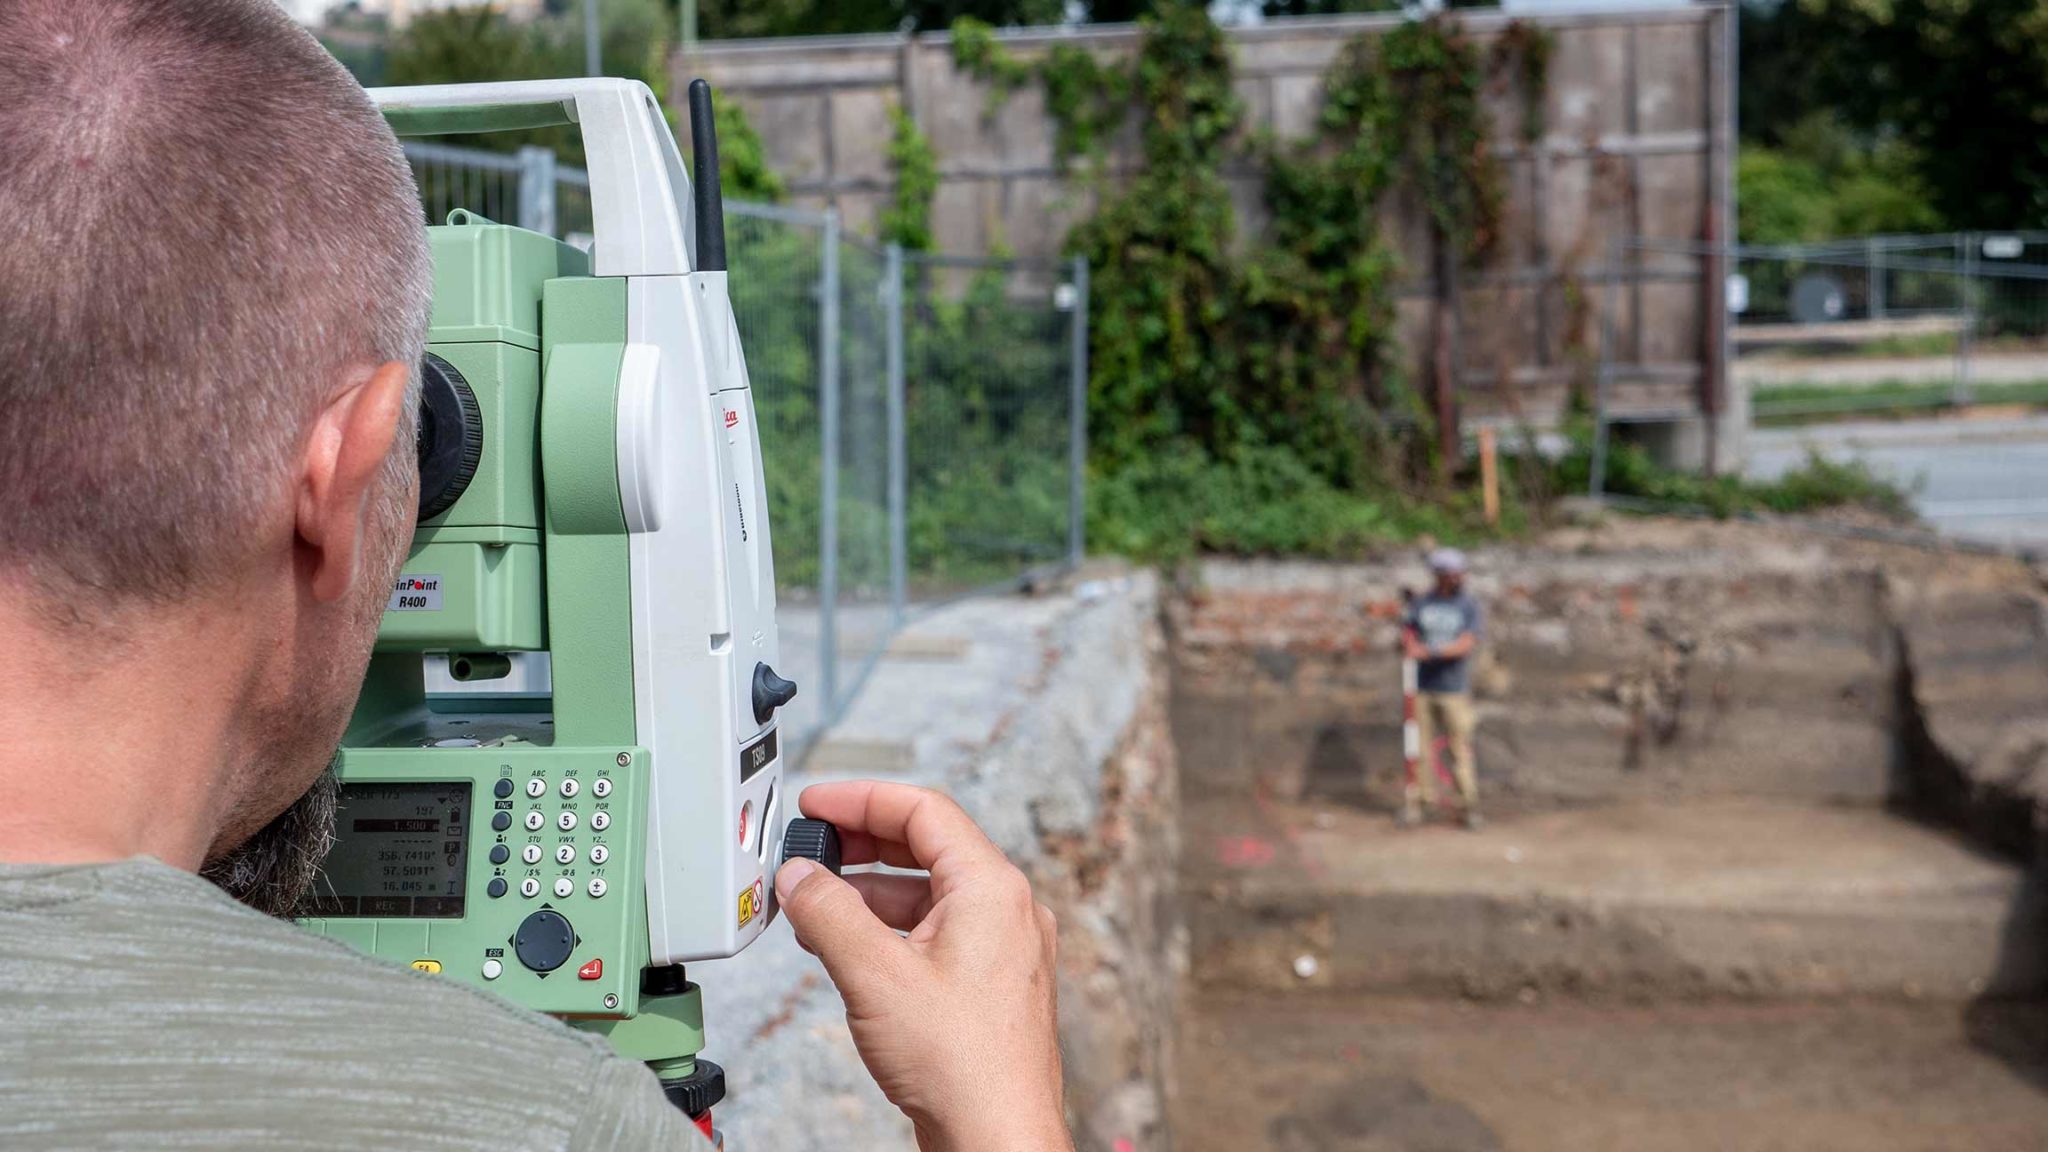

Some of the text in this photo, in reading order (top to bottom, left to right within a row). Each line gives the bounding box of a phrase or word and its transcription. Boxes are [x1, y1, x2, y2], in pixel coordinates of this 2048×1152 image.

[395, 578, 438, 591] inPoint
[399, 596, 427, 608] R400
[532, 782, 605, 793] 7 8 9
[496, 801, 512, 809] FNC
[529, 816, 603, 826] 4 5 6
[528, 849, 602, 860] 1 2 3
[526, 882, 533, 893] 0
[488, 949, 503, 957] ESC
